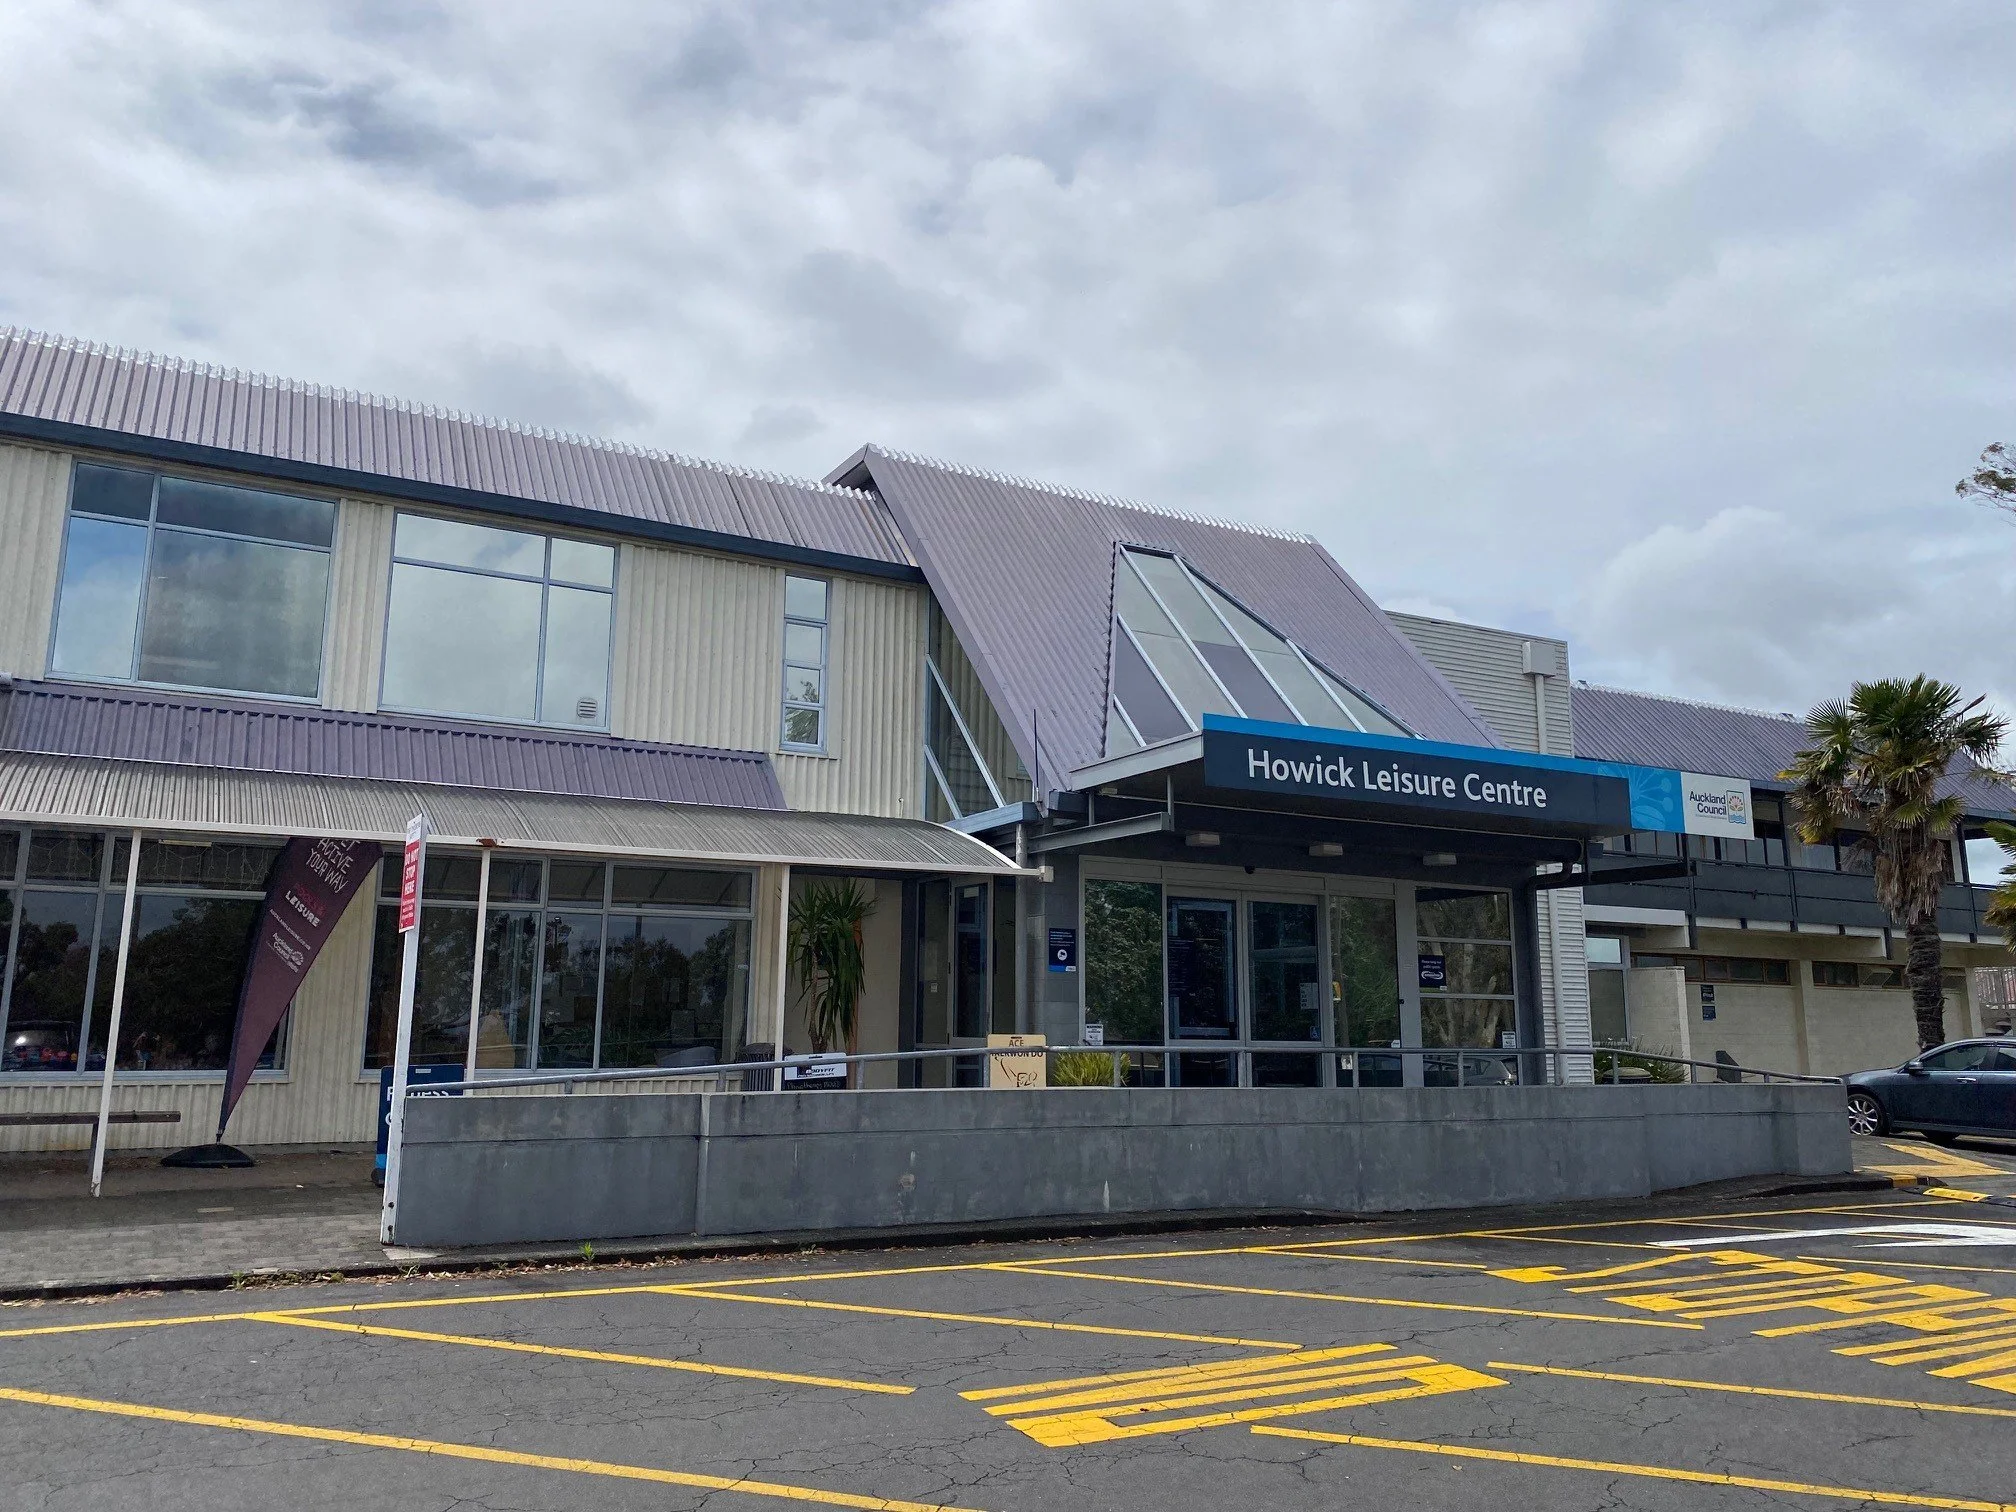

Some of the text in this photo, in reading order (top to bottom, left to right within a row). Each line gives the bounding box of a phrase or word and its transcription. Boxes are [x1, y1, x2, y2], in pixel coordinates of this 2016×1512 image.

[1248, 748, 1547, 808] Howick Leisure Centre
[1689, 791, 1727, 805] Auckland
[1697, 803, 1727, 815] Council
[306, 848, 349, 894] YOUR WAY
[317, 838, 354, 875] ACTIVE
[405, 865, 416, 881] STOP
[285, 890, 320, 927] LEISURE
[1009, 1039, 1024, 1047] ACE
[1482, 1250, 2016, 1394] STOPPI
[957, 1343, 1510, 1447] NO
